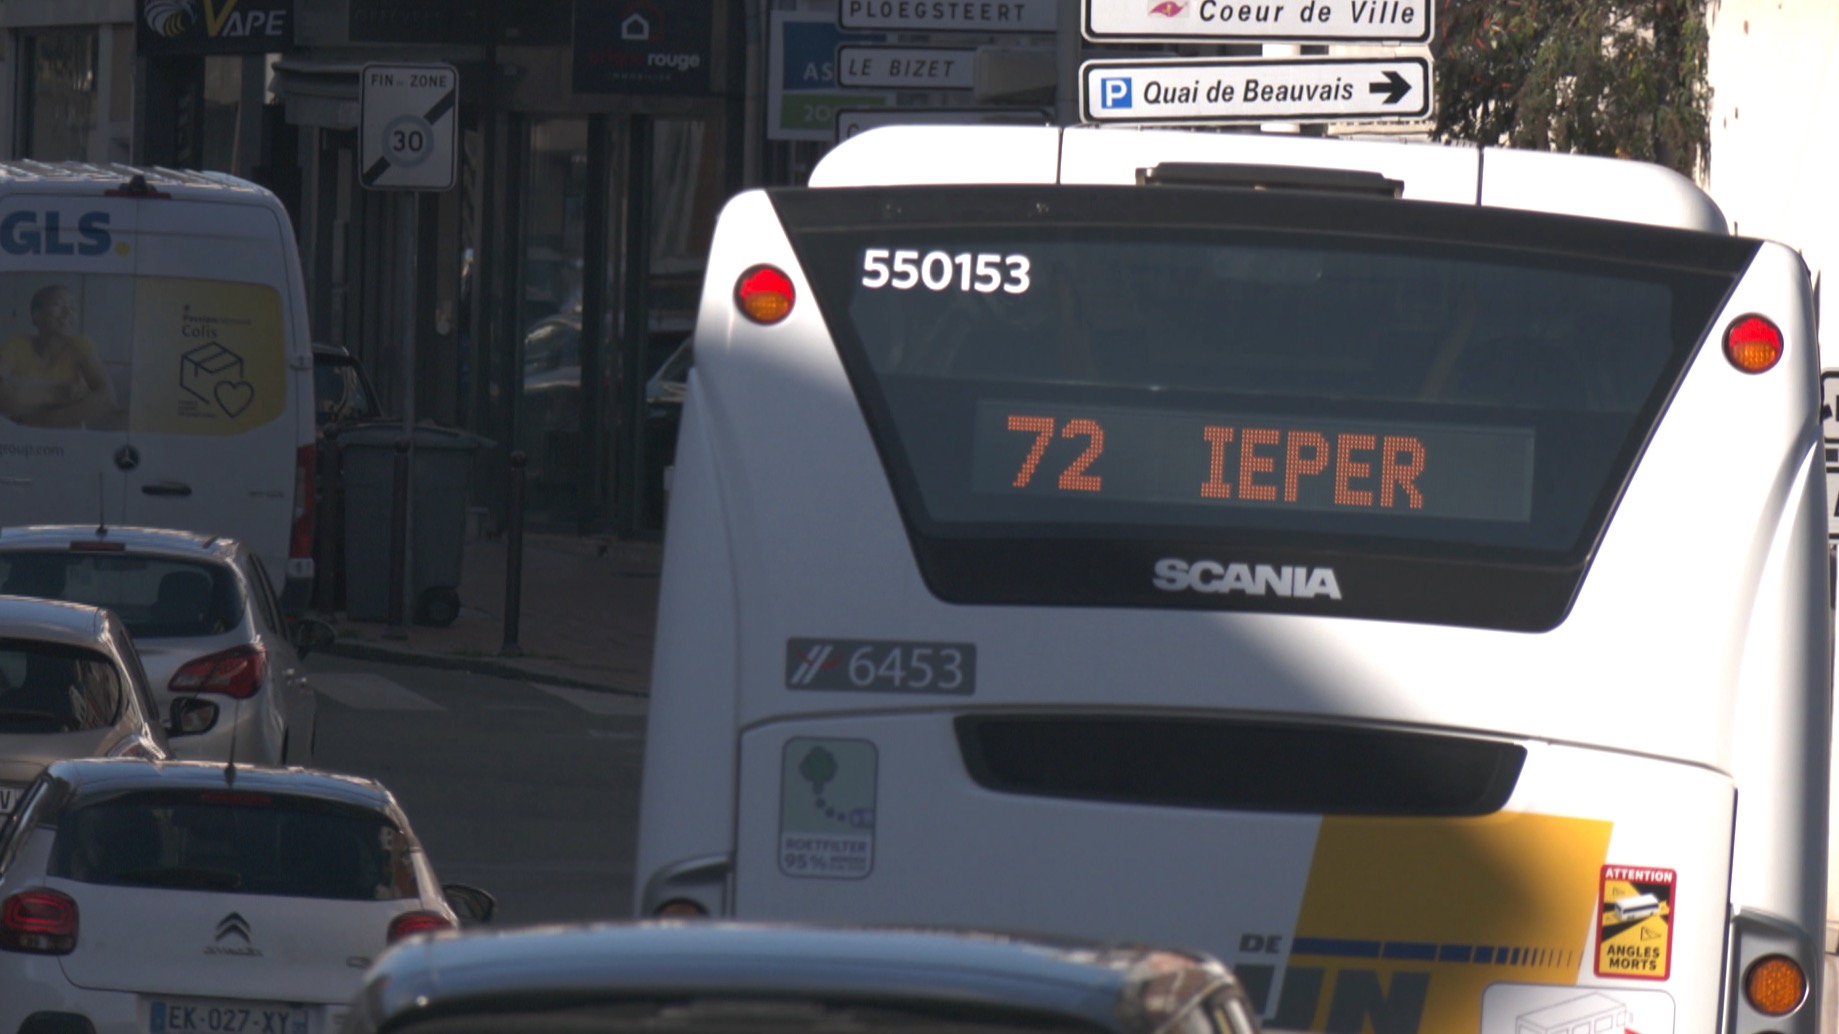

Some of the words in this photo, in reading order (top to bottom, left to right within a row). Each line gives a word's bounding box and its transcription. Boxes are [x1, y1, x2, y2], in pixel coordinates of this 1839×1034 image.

[203, 0, 287, 37] VAPE
[849, 0, 1025, 21] PLOEGSTEERT
[1200, 0, 1284, 22] Coeur
[1300, 0, 1331, 22] de
[1351, 0, 1415, 24] Ville
[647, 53, 701, 72] rouge
[848, 58, 873, 76] LE
[889, 59, 956, 78] BIZET
[371, 74, 394, 86] FIN
[410, 75, 447, 88] ZONE
[1104, 79, 1129, 108] P
[1143, 81, 1199, 105] Quai
[1206, 79, 1235, 103] de
[1242, 77, 1355, 103] Beauvais
[393, 130, 424, 152] 30
[862, 248, 1031, 294] 550153
[182, 324, 218, 339] Colis
[0, 443, 64, 459] roup.com
[1007, 415, 1104, 491] 72
[1201, 425, 1426, 509] IEPER
[1152, 557, 1342, 600] SCANIA
[848, 645, 964, 689] 6453
[1605, 867, 1673, 882] ATTENTION
[1238, 933, 1283, 955] DE
[1607, 944, 1661, 959] ANGLES
[1608, 957, 1657, 972] MORTS
[168, 1005, 290, 1034] EK-027-XY
